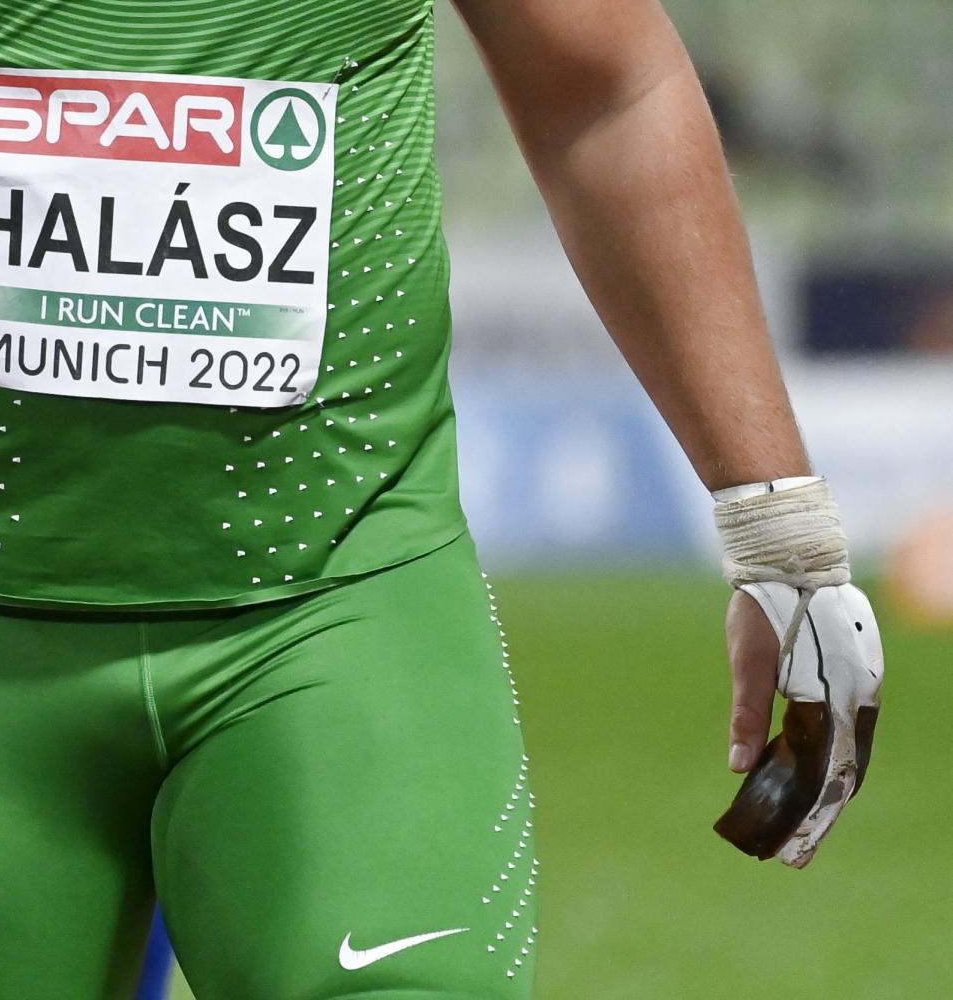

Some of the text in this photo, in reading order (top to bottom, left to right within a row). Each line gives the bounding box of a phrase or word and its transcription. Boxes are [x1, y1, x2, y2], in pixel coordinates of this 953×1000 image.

[40, 295, 47, 320] I
[58, 297, 124, 327] RUN
[189, 348, 301, 393] 2022
